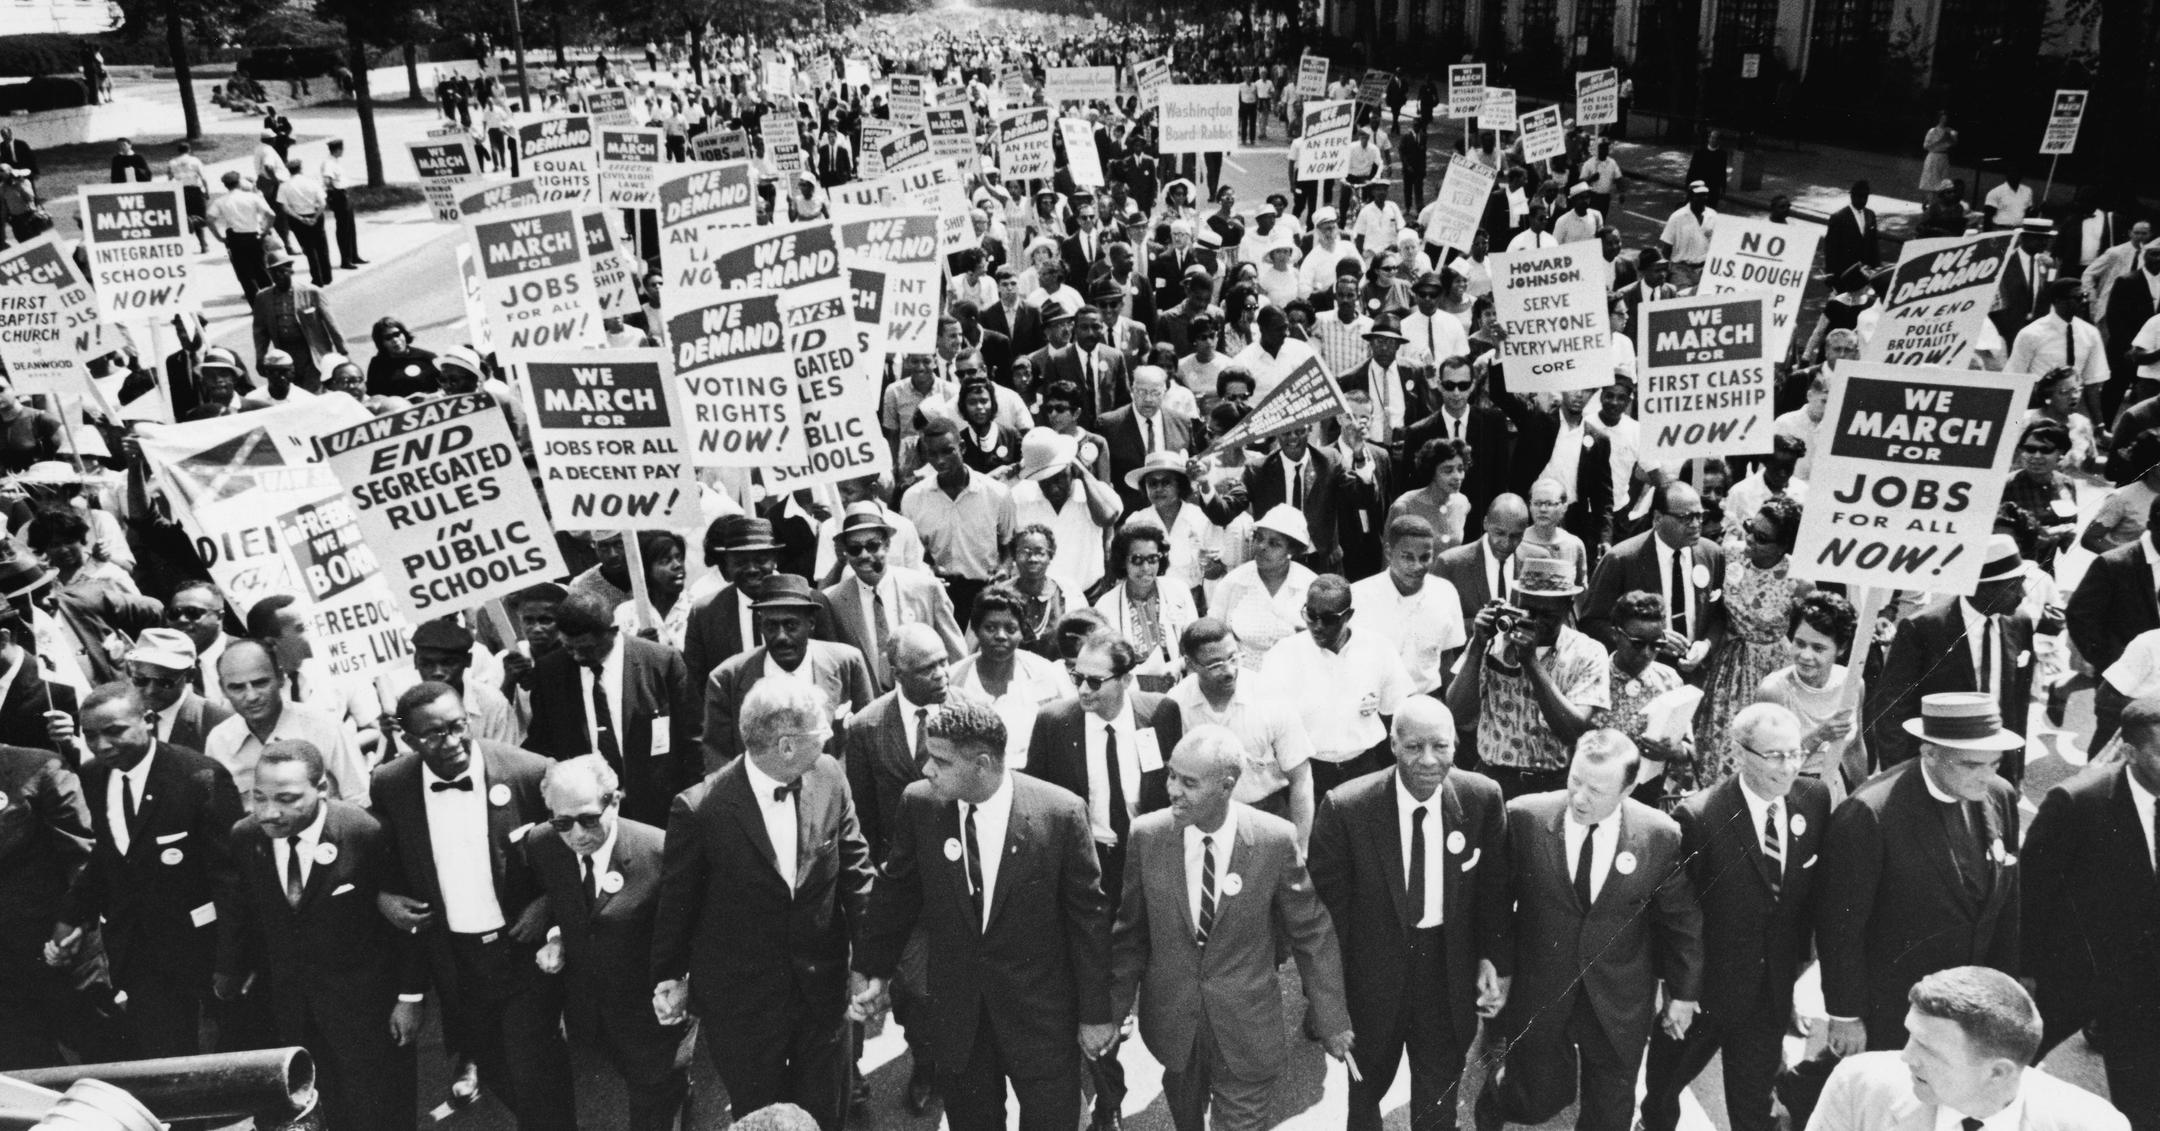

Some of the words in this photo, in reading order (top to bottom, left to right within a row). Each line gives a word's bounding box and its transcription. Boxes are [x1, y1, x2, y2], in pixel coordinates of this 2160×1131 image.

[1454, 74, 1481, 82] MARCH
[1165, 101, 1233, 120] Washington
[1320, 106, 1338, 121] WE
[1455, 104, 1482, 113] NOW!
[1584, 110, 1614, 120] NOW!
[541, 119, 568, 137] WE
[930, 119, 964, 129] MARCH
[1003, 119, 1047, 140] DEMAND
[1015, 112, 1032, 127] WE
[1306, 113, 1350, 137] DEMAND
[524, 129, 590, 155] DEMAND
[622, 134, 639, 143] WE
[1166, 124, 1196, 140] Board
[427, 147, 445, 156] WE
[607, 142, 655, 155] MARCH
[1005, 144, 1020, 152] AN
[1024, 141, 1049, 150] FEPC
[1306, 140, 1320, 149] AN
[1325, 136, 1348, 146] FEPC
[1531, 143, 1560, 157] NOW!
[419, 155, 465, 168] MARCH
[1015, 152, 1040, 161] LAW
[1314, 150, 1338, 160] LAW
[534, 160, 587, 172] EQUAL
[1009, 160, 1048, 174] NOW!
[1306, 158, 1345, 174] NOW!
[688, 171, 721, 196] WE
[117, 195, 145, 209] WE
[484, 185, 512, 208] WE
[610, 190, 656, 203] NOW!
[667, 183, 748, 223] DEMAND
[97, 209, 173, 230] MARCH
[440, 209, 458, 220] NO
[122, 229, 152, 239] FOR
[510, 218, 543, 238] WE
[670, 228, 698, 244] AN
[867, 218, 906, 242] WE
[96, 244, 184, 264] INTEGRATED
[489, 231, 572, 264] MARCH
[753, 235, 797, 269] WE
[843, 236, 935, 262] DEMAND
[1740, 232, 1786, 257] NO
[1, 256, 30, 277] WE
[518, 257, 552, 271] FOR
[592, 257, 620, 275] ASS
[1510, 256, 1573, 275] HOWARD
[1930, 244, 1978, 273] WE
[101, 265, 187, 285] SCHOOLS
[680, 267, 713, 287] NO
[730, 250, 835, 290] DEMAND
[1710, 257, 1737, 279] U.S.
[1741, 263, 1804, 289] DOUGH
[500, 273, 580, 308] JOBS
[1894, 257, 1999, 304] DEMAND
[1, 296, 47, 310] FIRST
[113, 283, 185, 311] NOW!
[1523, 293, 1570, 312] SERVE
[0, 312, 58, 327] BAPTIST
[506, 308, 541, 322] FOR
[552, 300, 581, 314] ALL
[702, 303, 743, 334] WE
[1688, 308, 1723, 327] WE
[1895, 306, 1930, 319] AN
[1933, 300, 1975, 317] END
[511, 312, 589, 348] NOW!
[887, 320, 927, 342] W!
[1506, 312, 1597, 335] EVERYONE
[1906, 321, 1954, 336] POLICE
[2, 329, 60, 342] CHURCH
[679, 321, 780, 368] DEMAND
[1504, 333, 1606, 356] EVERYWHERE
[1656, 324, 1754, 352] MARCH
[1887, 333, 1959, 350] BRUTALITY
[794, 347, 854, 379] GATED
[1686, 350, 1724, 362] FOR
[1884, 340, 1967, 366] NOW!
[13, 360, 73, 370] DEANWOOD
[1532, 359, 1576, 375] CORE
[572, 367, 615, 386] WE
[685, 377, 787, 396] VOTING
[1648, 373, 1700, 392] FIRST
[1707, 367, 1763, 388] CLASS
[544, 388, 657, 411] MARCH
[798, 376, 844, 404] LES
[1644, 389, 1766, 414] CITIZENSHIP
[1904, 388, 1954, 413] WE
[331, 418, 393, 451] UAW
[401, 394, 486, 431] SAYS:
[581, 414, 626, 426] FOR
[696, 404, 786, 422] RIGHTS
[698, 425, 790, 452] NOW!
[804, 417, 864, 448] BLIC
[1657, 414, 1757, 447] NOW!
[1847, 411, 1993, 446] MARCH
[370, 425, 473, 475] END
[544, 440, 592, 456] JOBS
[596, 440, 636, 455] FOR
[642, 438, 678, 455] ALL
[1887, 445, 1942, 461] FOR
[352, 443, 512, 510] SEGREGATED
[549, 466, 563, 480] A
[566, 465, 636, 480] DECENT
[642, 464, 681, 479] PAY
[571, 487, 680, 517] NOW!
[1833, 473, 1972, 513] JOBS
[386, 477, 501, 530] RULES
[1832, 511, 1888, 528] FOR
[1906, 519, 1957, 534] ALL
[312, 534, 338, 556] WE
[402, 520, 531, 580] PUBLIC
[1816, 537, 1964, 576] NOW!
[306, 543, 380, 597] BORN
[410, 547, 547, 609] SCHOOLS
[328, 641, 347, 656] WE
[368, 627, 415, 664] LIVE
[328, 654, 367, 676] MUST
